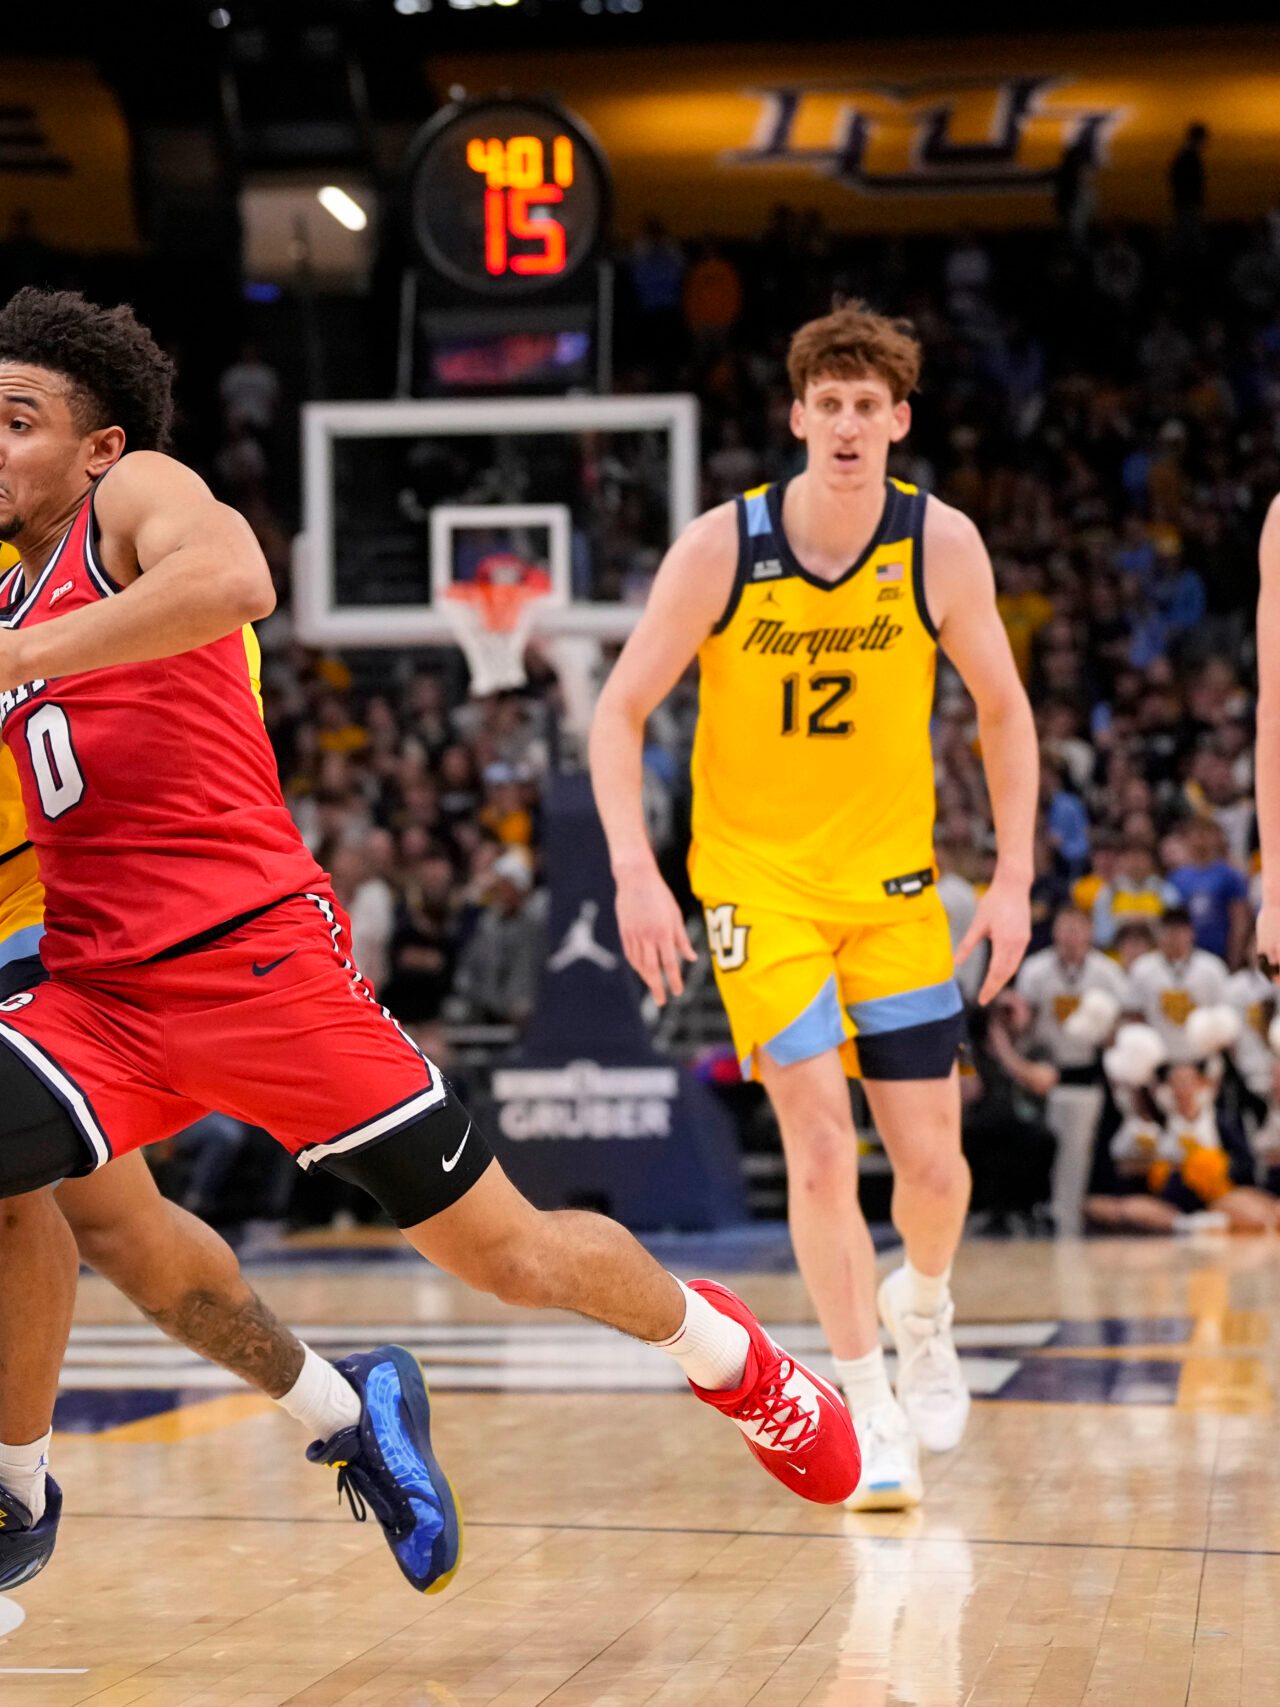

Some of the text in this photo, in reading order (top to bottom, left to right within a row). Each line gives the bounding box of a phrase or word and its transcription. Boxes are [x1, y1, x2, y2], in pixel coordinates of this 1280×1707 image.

[484, 184, 567, 275] 15
[741, 613, 904, 665] Marquette
[781, 670, 857, 739] 12
[25, 701, 87, 822] 0
